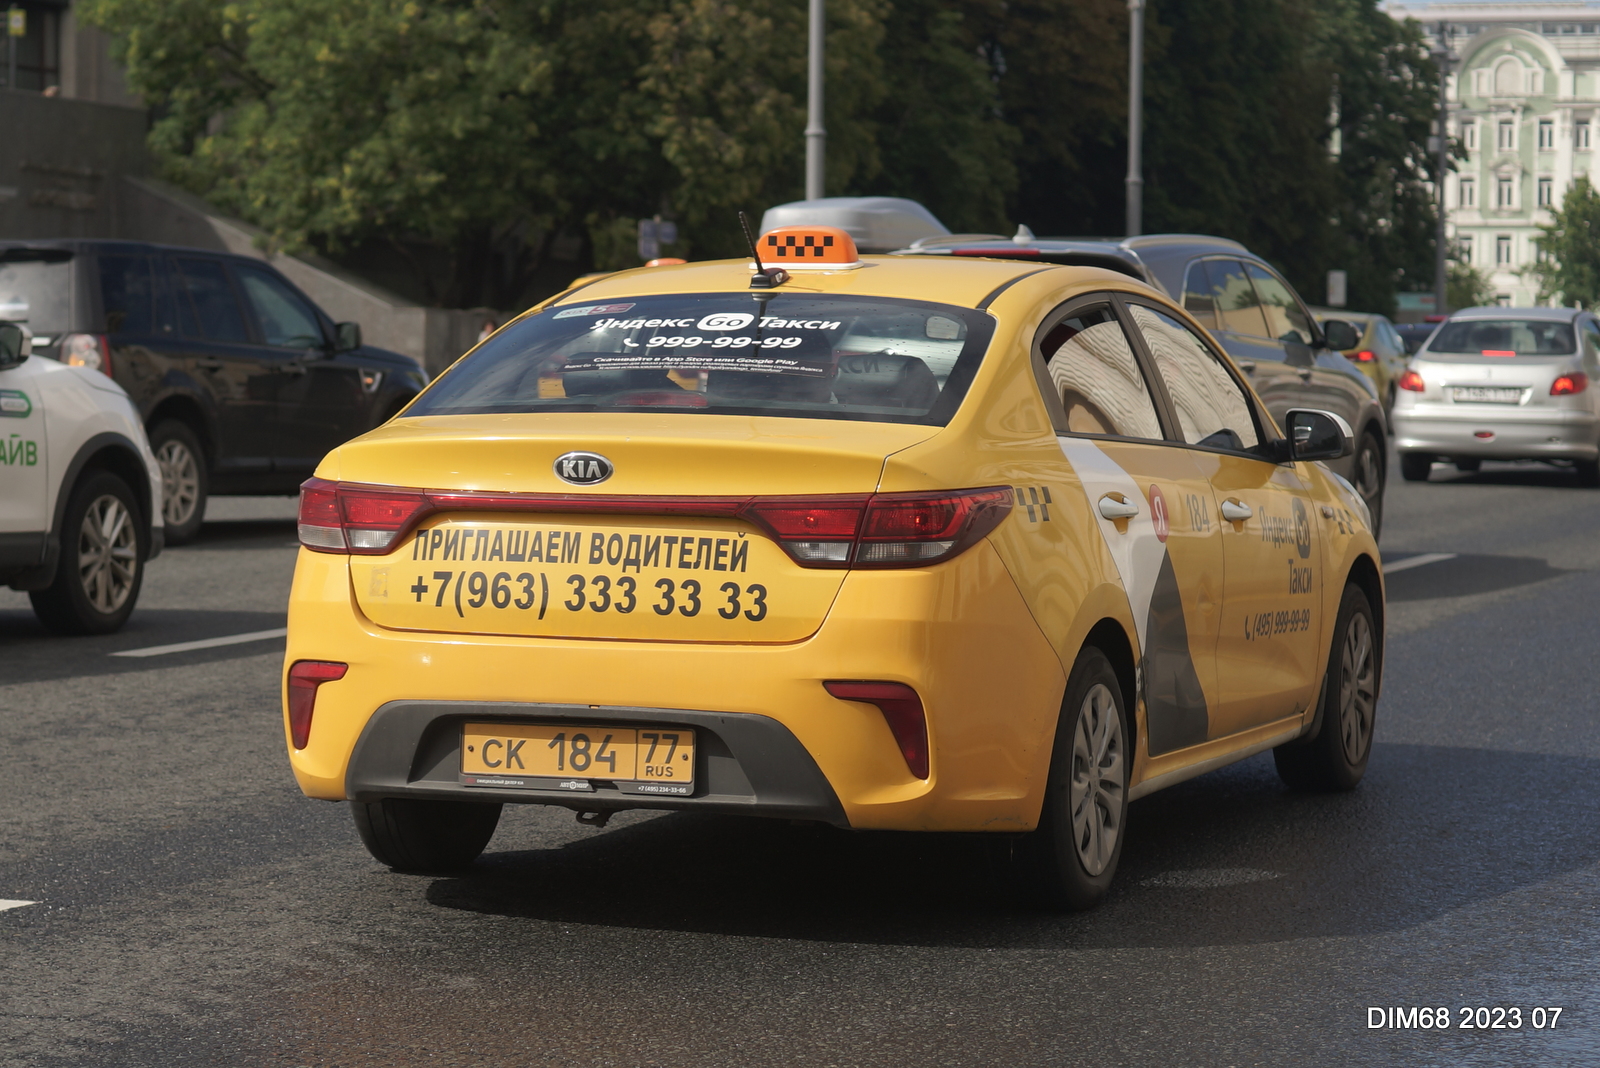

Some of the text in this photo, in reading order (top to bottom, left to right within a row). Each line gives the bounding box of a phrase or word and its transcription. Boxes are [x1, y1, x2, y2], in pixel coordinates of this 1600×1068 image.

[589, 317, 695, 330] Яндекс
[758, 316, 841, 330] Такси
[646, 336, 802, 348] 999-99-99
[775, 358, 798, 366] Play
[561, 458, 601, 478] KIA
[1152, 496, 1166, 531] Я
[1186, 494, 1210, 532] 184
[1258, 506, 1295, 549] Яндекс
[412, 529, 750, 573] ПРИГЛАШАЕМ ВОДИТЕЛЕЙ
[1288, 559, 1312, 595] Такси
[410, 570, 768, 622] +7(963) 333 33 33
[1252, 609, 1310, 642] (495) 999-99-99
[482, 732, 616, 773] СК 184
[641, 732, 680, 764] 77
[645, 765, 673, 777] RUS
